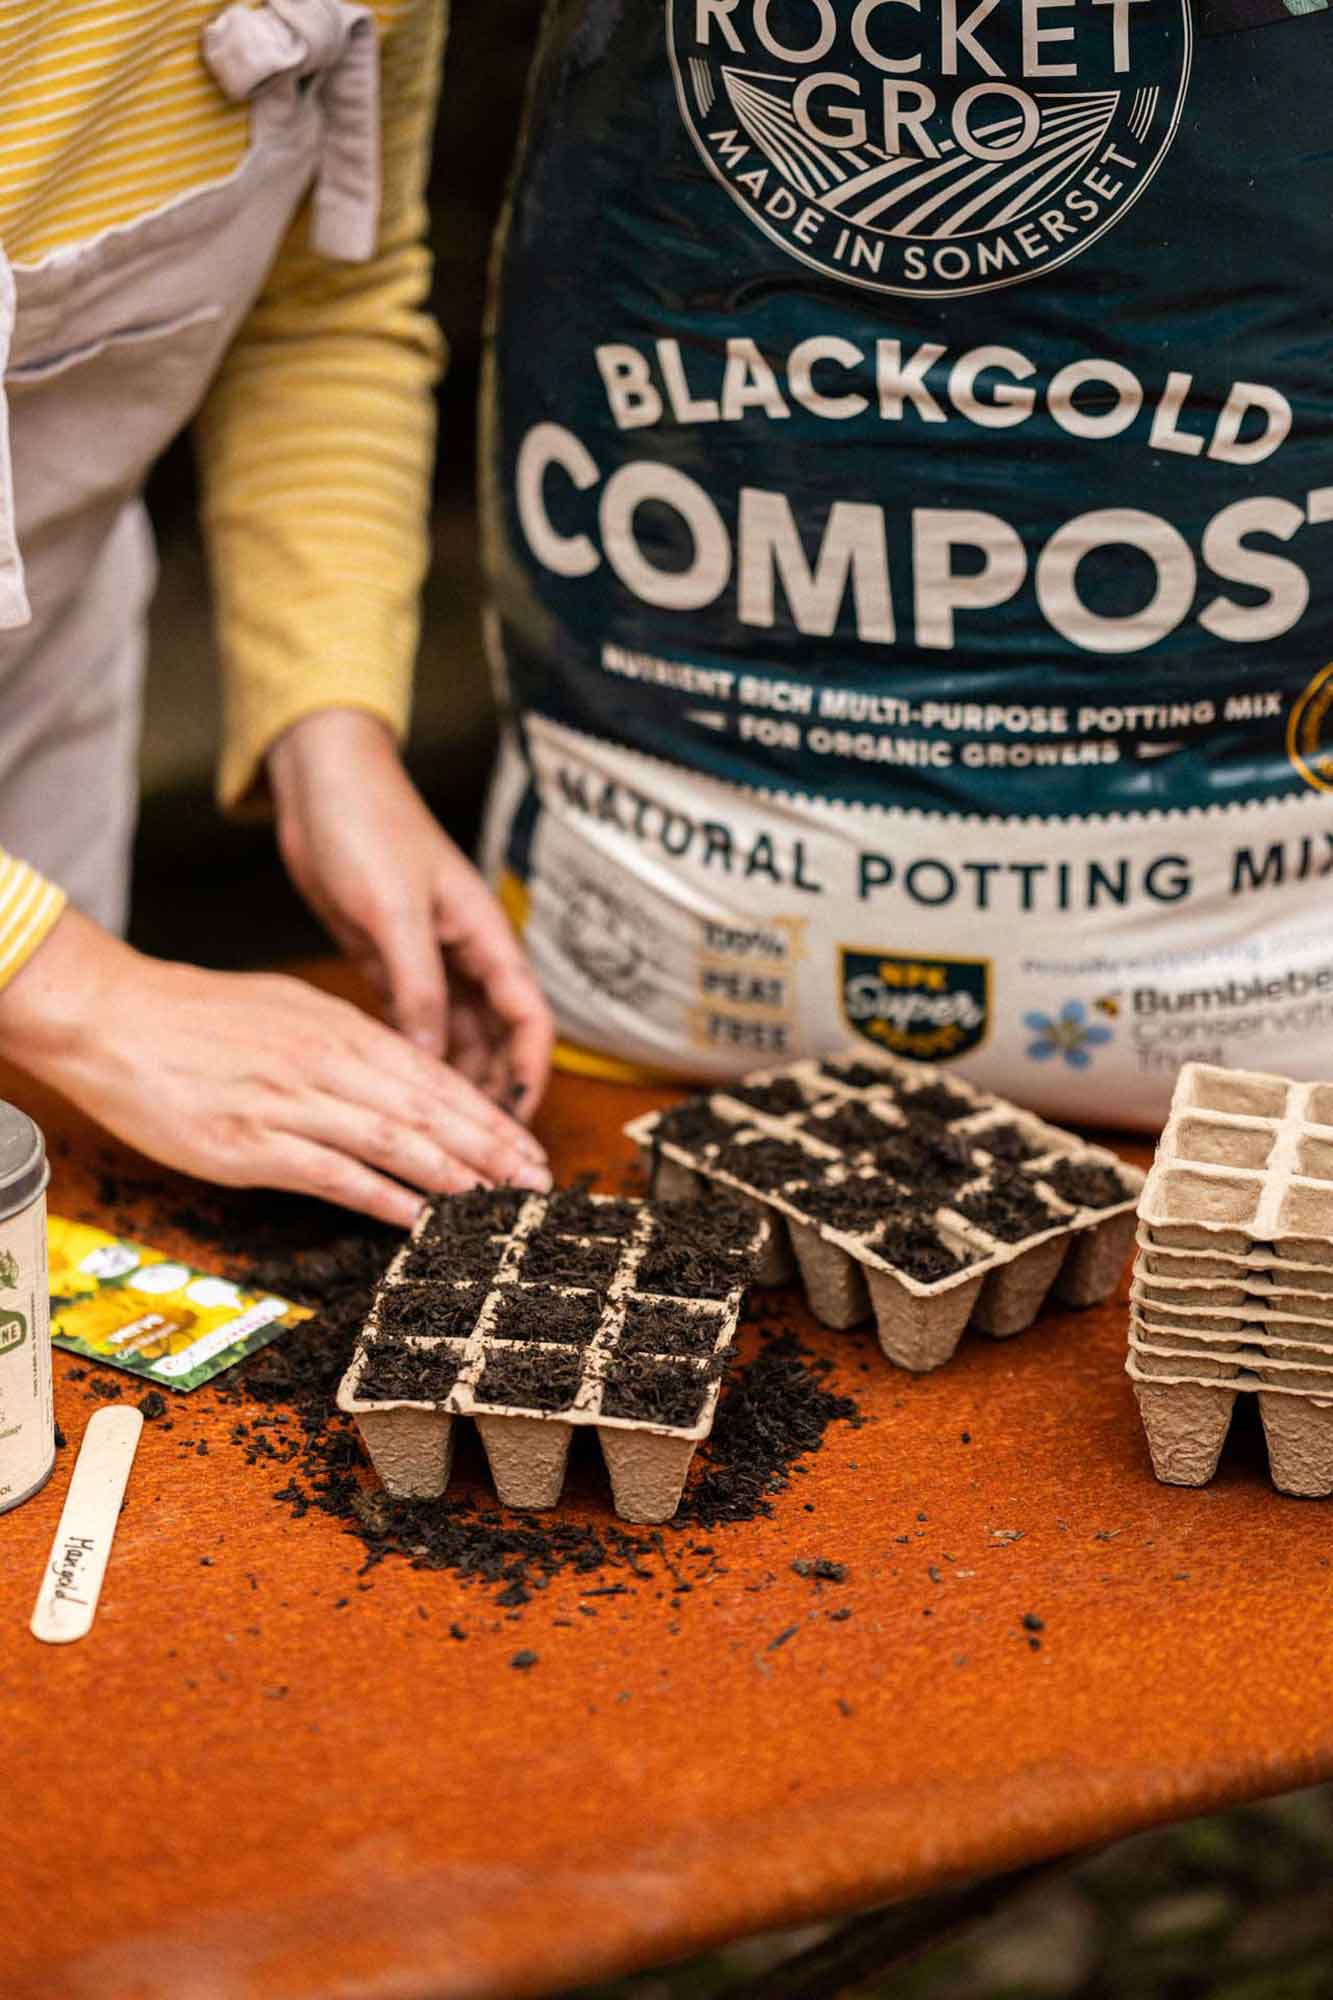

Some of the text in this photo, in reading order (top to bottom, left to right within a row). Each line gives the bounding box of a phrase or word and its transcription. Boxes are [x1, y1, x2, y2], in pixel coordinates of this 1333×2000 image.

[696, 0, 1152, 78] ROCKET
[791, 72, 1041, 163] GRO
[708, 129, 1138, 281] MADE IN SOMERSET
[595, 336, 1294, 465] BLACKGOLD
[515, 421, 1333, 654] COMPOS
[602, 642, 734, 698] NUTRIENT
[738, 673, 813, 715] RICH
[819, 689, 1068, 733] MULTI-PURPOSE
[1077, 701, 1215, 733] POTTING
[1224, 692, 1281, 721] MIX
[738, 714, 1120, 767] FOR ORGANIC GROWERS
[558, 768, 823, 894] NATURAL
[857, 853, 1193, 912] POTTING
[702, 970, 785, 1005] PEAT
